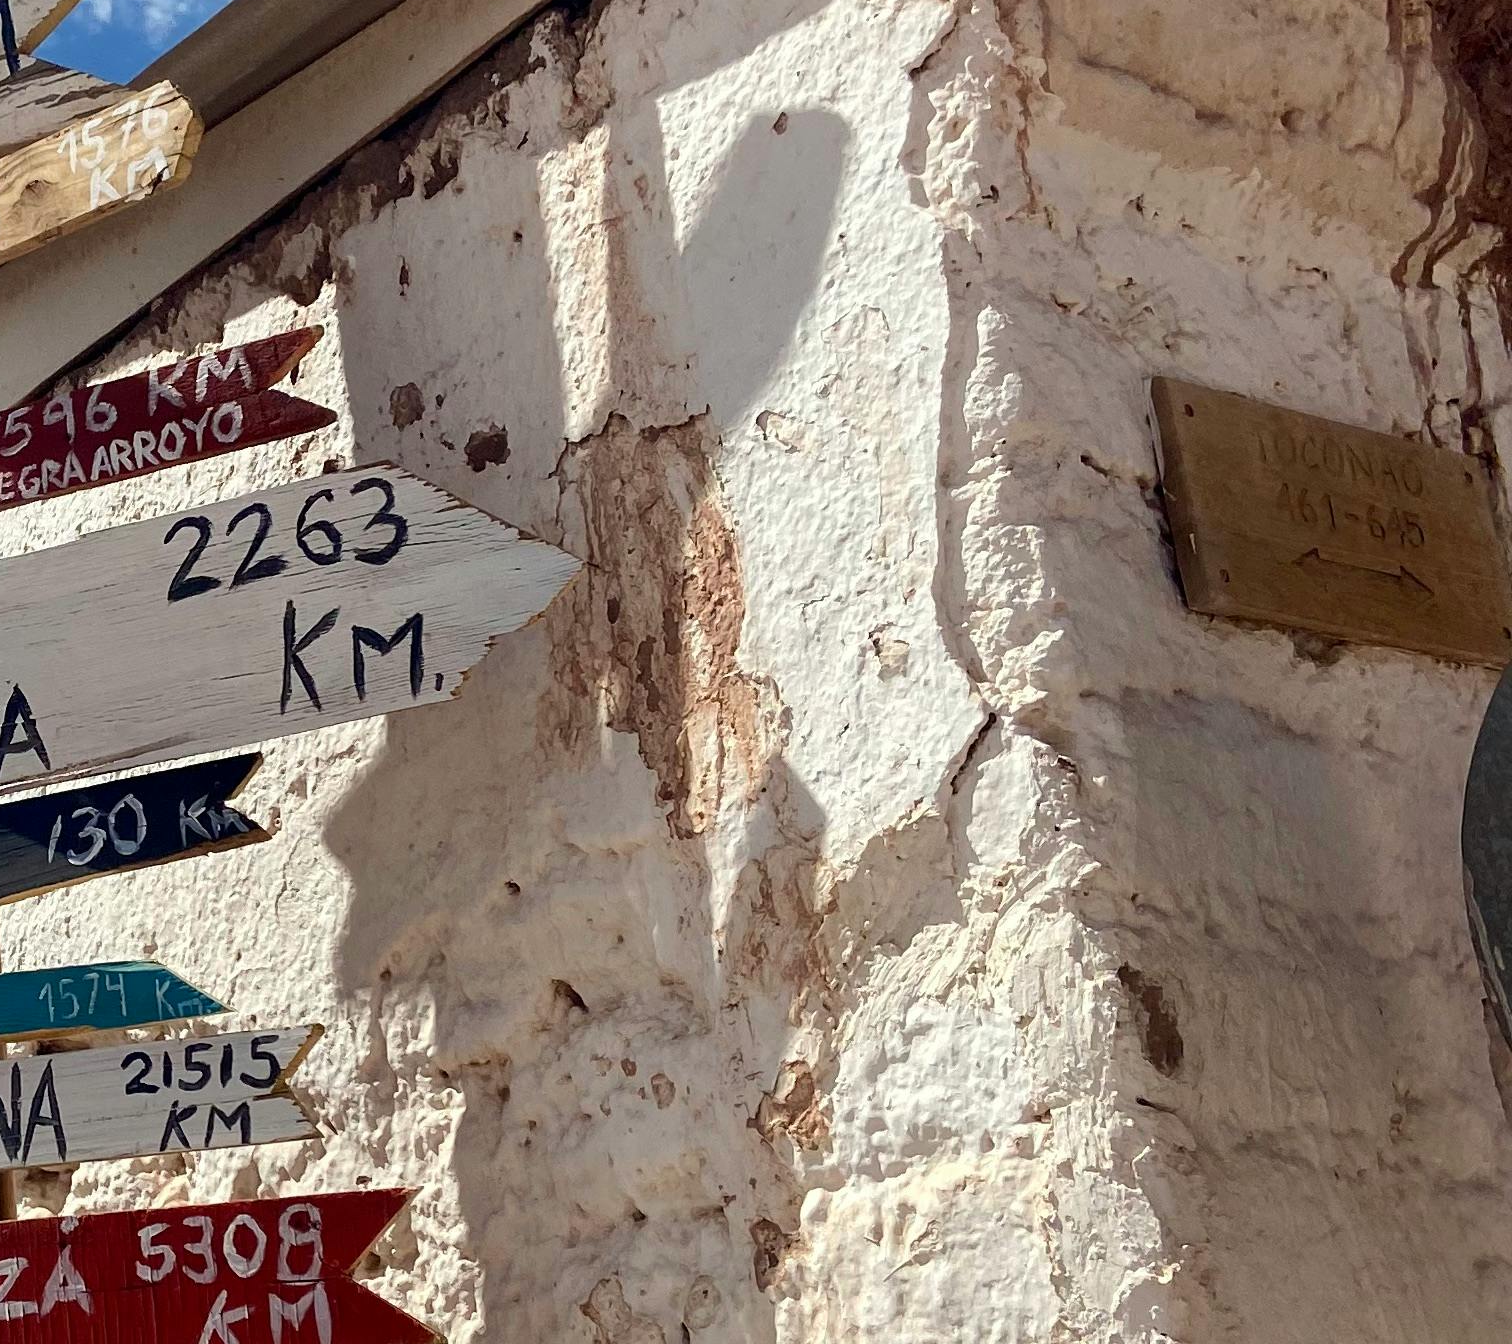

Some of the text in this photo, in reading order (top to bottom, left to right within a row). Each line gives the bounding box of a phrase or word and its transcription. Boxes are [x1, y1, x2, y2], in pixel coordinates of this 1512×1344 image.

[57, 87, 170, 175] 1576
[89, 146, 172, 210] KM
[147, 346, 254, 416] KM
[163, 476, 408, 604] 2263
[47, 792, 148, 867] 130
[38, 971, 128, 1023] 1574
[120, 1034, 281, 1095] 21515
[159, 1100, 252, 1152] KM
[135, 1202, 324, 1285] 5308
